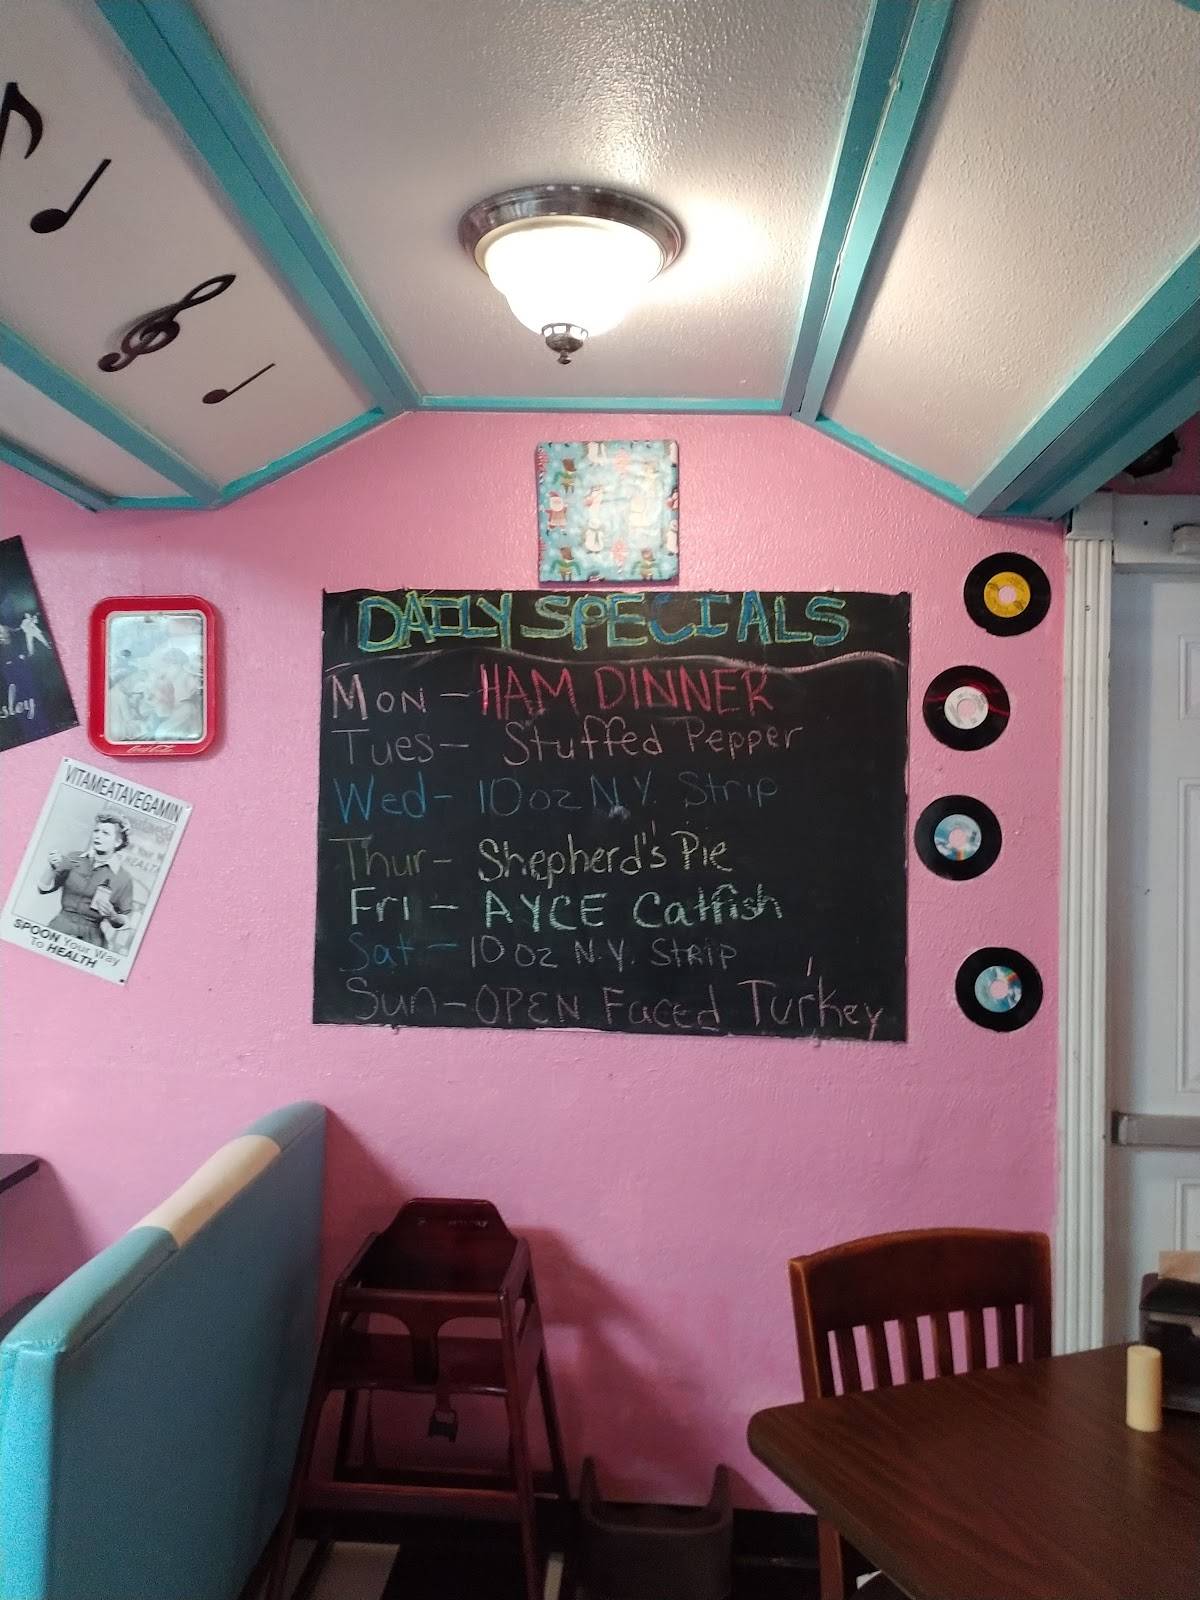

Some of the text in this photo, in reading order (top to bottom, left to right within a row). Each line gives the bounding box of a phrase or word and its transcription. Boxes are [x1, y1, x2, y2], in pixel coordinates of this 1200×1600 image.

[357, 591, 850, 651] DAILY SPECIALS
[478, 663, 578, 720] HAM
[594, 664, 774, 716] DINNER
[503, 714, 663, 766] Stuffed
[661, 715, 803, 760] Pepper
[65, 764, 184, 823] VITAMEATAVEGAMIN
[678, 770, 778, 808] Strip
[478, 833, 667, 889] Shepherd's
[671, 830, 733, 872] Pie
[14, 918, 61, 943] SPOON
[486, 889, 607, 932] AYCE
[633, 883, 782, 928] Catfish
[46, 942, 98, 968] HEALTH
[339, 932, 414, 972] Sat
[475, 984, 580, 1024] OPEN
[603, 985, 720, 1032] Faced
[737, 975, 883, 1040] Turkey
